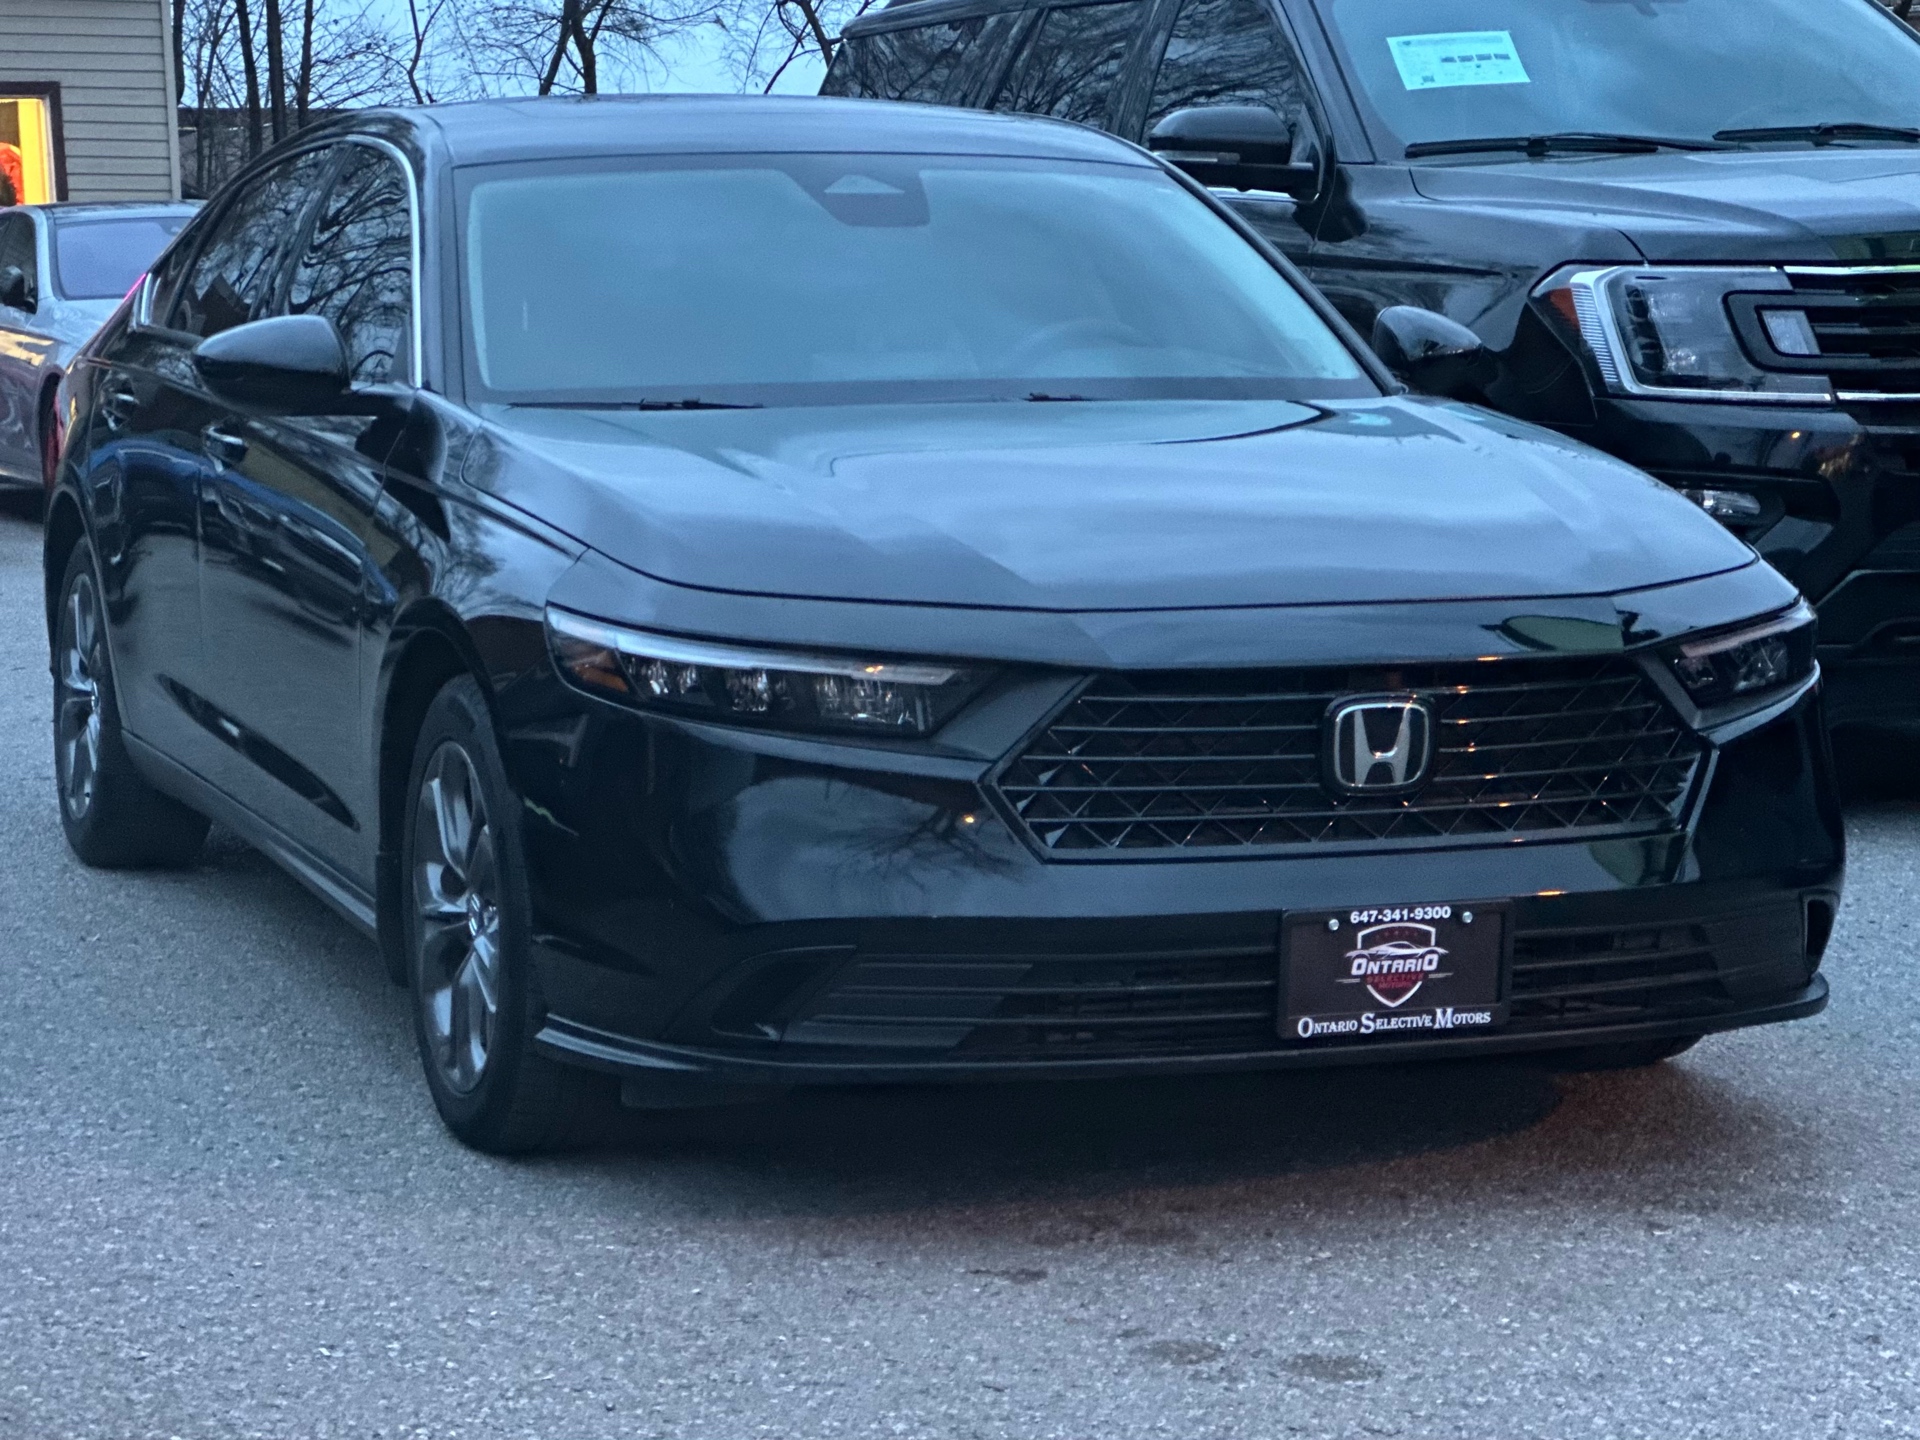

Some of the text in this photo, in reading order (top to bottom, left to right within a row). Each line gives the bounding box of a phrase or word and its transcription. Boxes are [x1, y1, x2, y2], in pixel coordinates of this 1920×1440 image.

[1350, 906, 1451, 924] 647-341-9300
[1351, 953, 1439, 976] ONTARIO
[1297, 1008, 1491, 1038] ONTARIO SELECTIVE MOTORS
